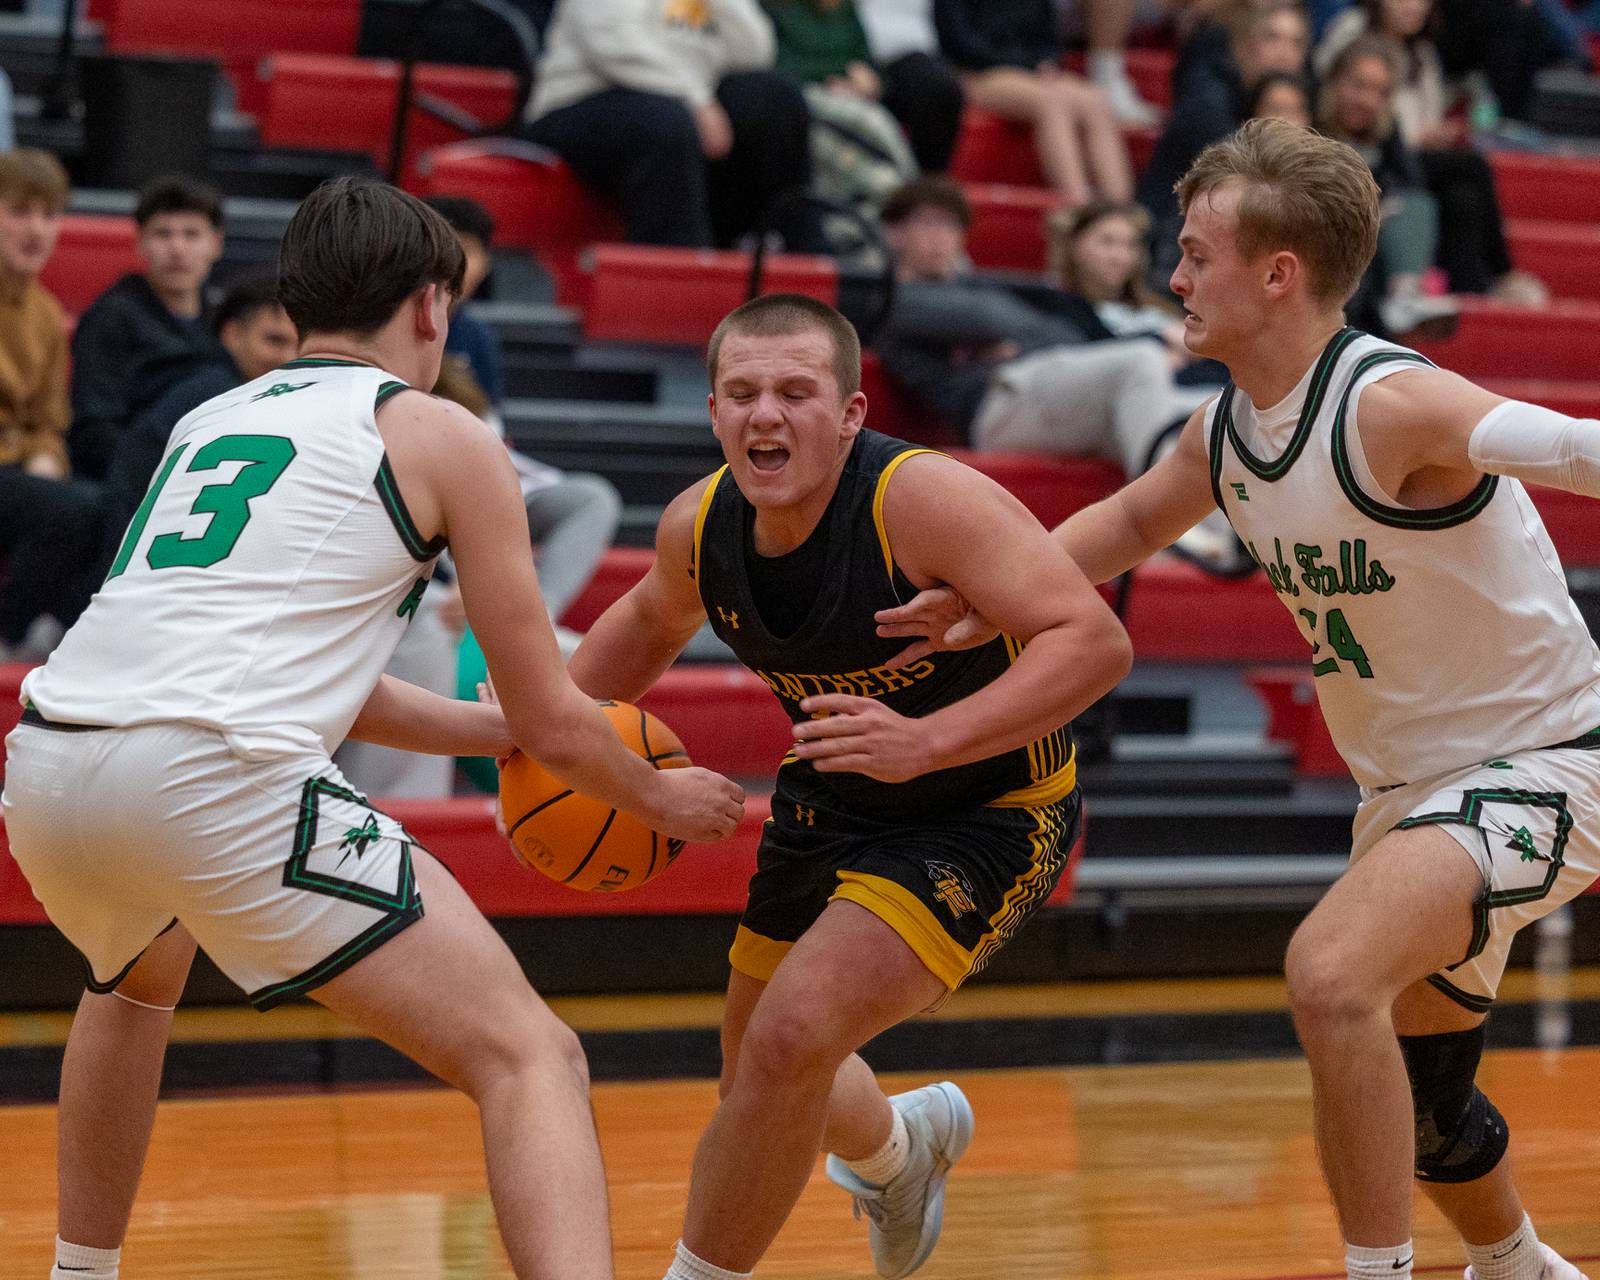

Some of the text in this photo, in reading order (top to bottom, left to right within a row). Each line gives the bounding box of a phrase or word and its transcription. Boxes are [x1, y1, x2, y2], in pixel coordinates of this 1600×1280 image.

[106, 434, 297, 583] 13
[1294, 539, 1395, 597] Falls
[1299, 608, 1374, 678] 24
